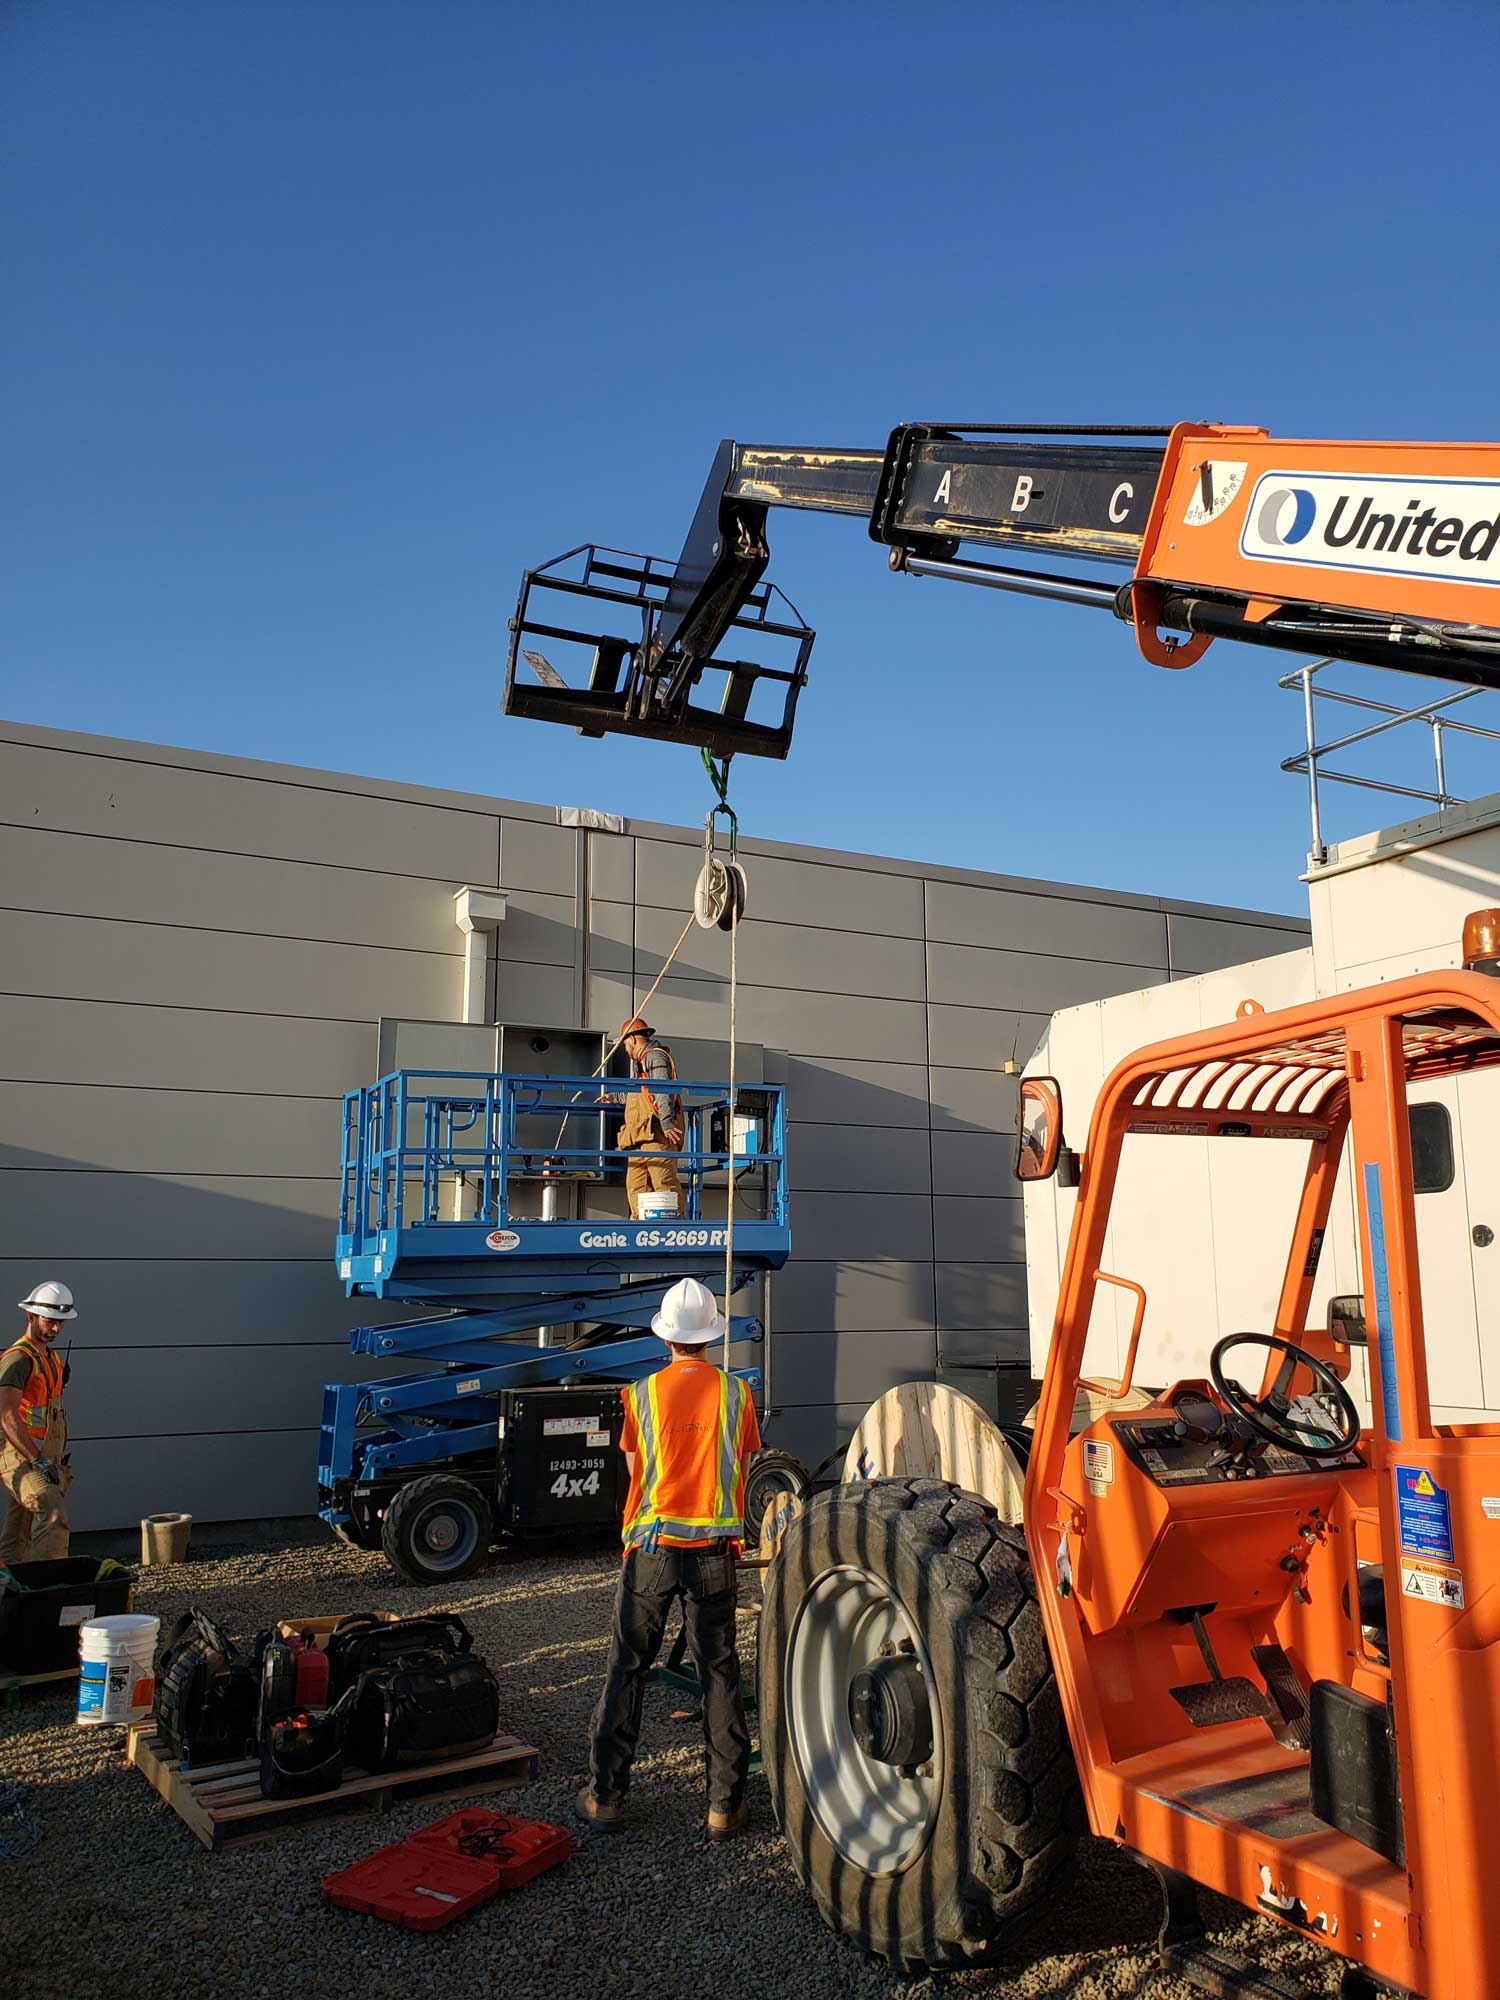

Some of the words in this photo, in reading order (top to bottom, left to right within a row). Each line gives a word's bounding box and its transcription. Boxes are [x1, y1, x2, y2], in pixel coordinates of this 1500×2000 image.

[933, 470, 951, 504] A
[1010, 475, 1033, 512] B
[1108, 482, 1134, 524] C
[1323, 495, 1500, 562] United
[579, 1231, 628, 1248] Genie
[635, 1230, 708, 1247] GS-2669
[550, 1458, 605, 1472] 12493-3059
[550, 1470, 600, 1498] 4x4
